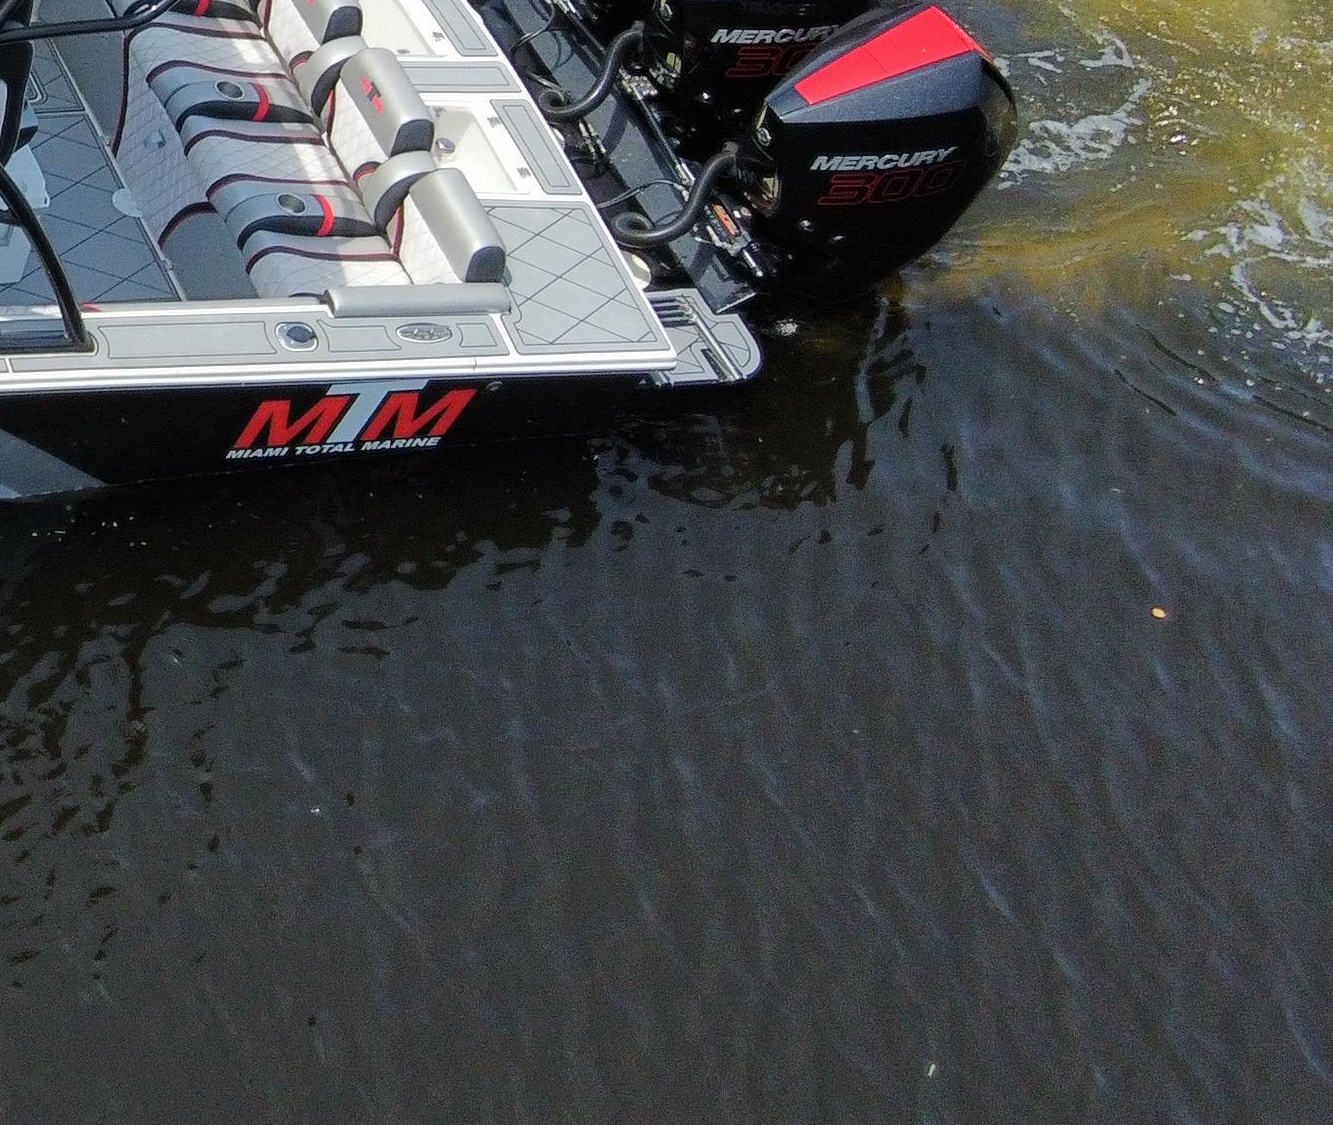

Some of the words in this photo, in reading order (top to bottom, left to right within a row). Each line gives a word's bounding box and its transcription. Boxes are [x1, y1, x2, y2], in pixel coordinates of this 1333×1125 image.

[808, 145, 959, 171] MERCURY
[816, 161, 965, 206] 300
[234, 378, 478, 448] MTM
[225, 446, 289, 459] MIAMI
[294, 442, 356, 455] TOTAL
[360, 436, 443, 452] MARINE
